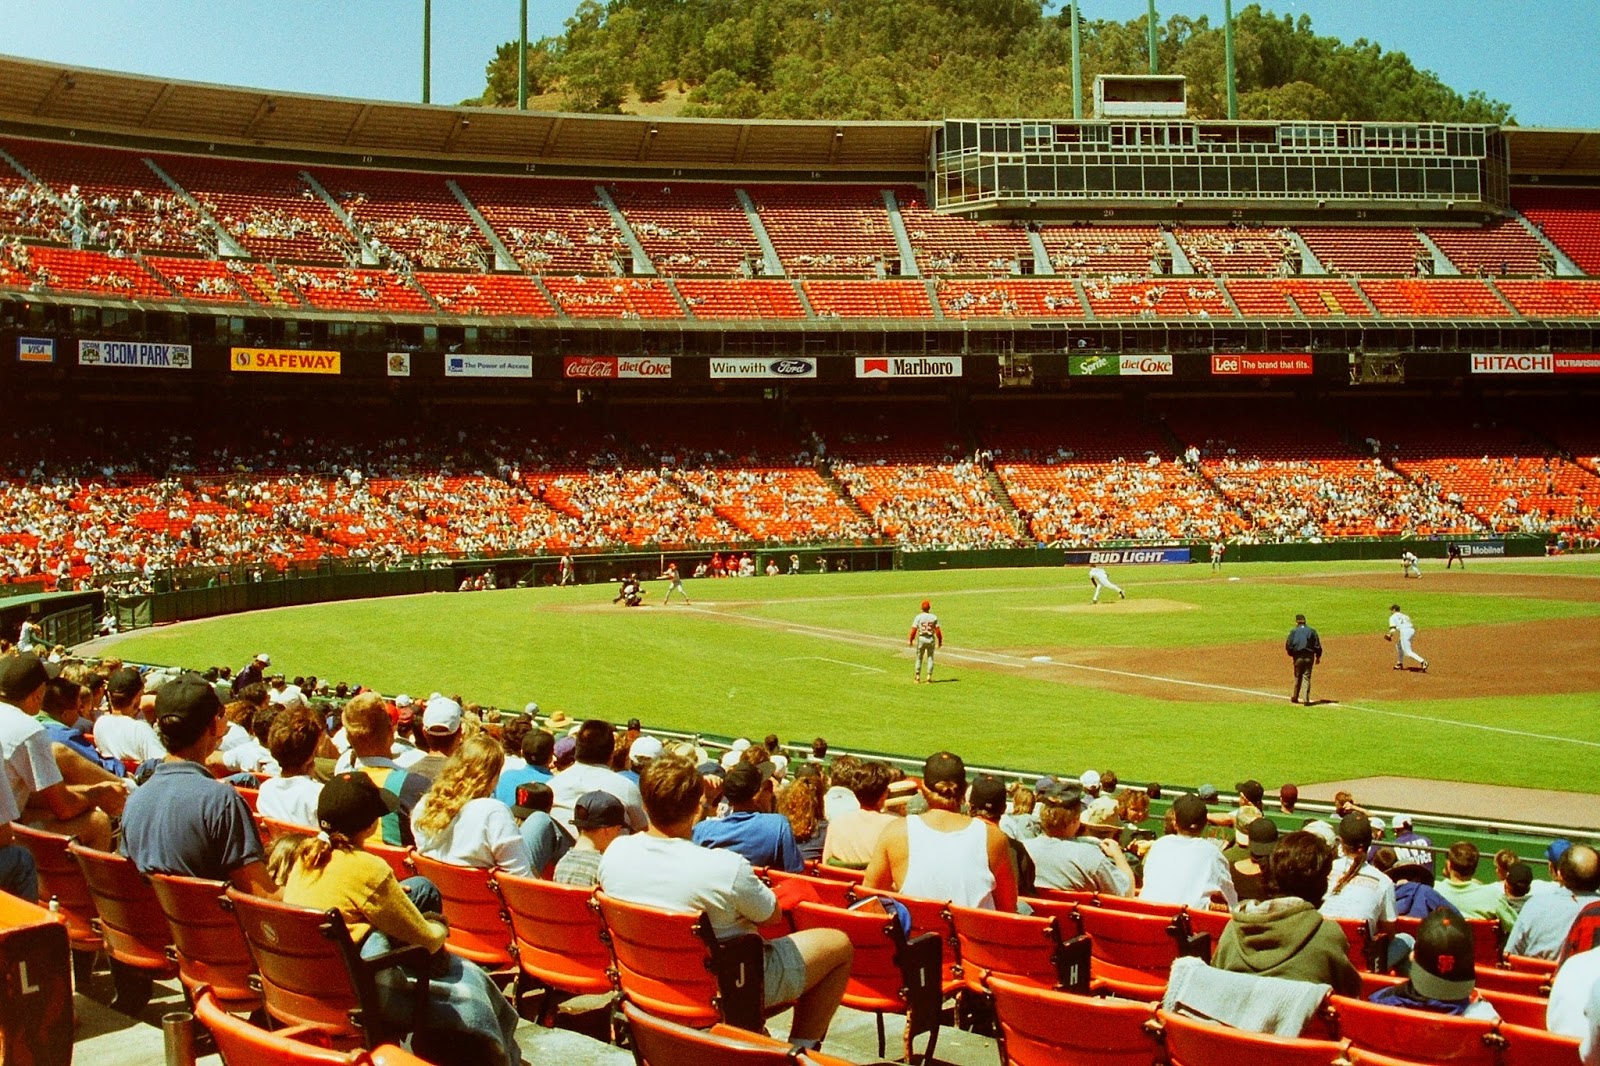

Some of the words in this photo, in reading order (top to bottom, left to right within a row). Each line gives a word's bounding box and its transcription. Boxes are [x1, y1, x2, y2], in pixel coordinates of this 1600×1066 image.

[362, 155, 373, 163] 10
[1232, 209, 1243, 217] 22
[28, 345, 45, 354] VISA
[104, 343, 138, 365] 3COM
[140, 345, 170, 366] PARK
[256, 353, 336, 368] SAFEWAY
[620, 362, 639, 372] diet
[638, 360, 671, 375] Coke
[712, 362, 736, 373] Win
[739, 362, 766, 373] with
[777, 360, 805, 373] Ford
[893, 358, 953, 375] Marlboro
[1080, 357, 1108, 375] Sprite
[1121, 359, 1140, 370] diet
[1139, 358, 1172, 372] Coke
[1215, 357, 1238, 371] Lee
[1242, 360, 1256, 369] The
[1257, 360, 1278, 369] brand
[1279, 360, 1294, 369] that
[1295, 360, 1310, 369] fits.
[1474, 356, 1551, 370] HITACHI
[1472, 545, 1505, 555] Mobilnet
[1089, 552, 1121, 564] BUD
[1121, 551, 1165, 563] LIGHT
[19, 960, 40, 994] L
[735, 962, 745, 988] J
[919, 967, 926, 987] I
[1070, 963, 1079, 986] H
